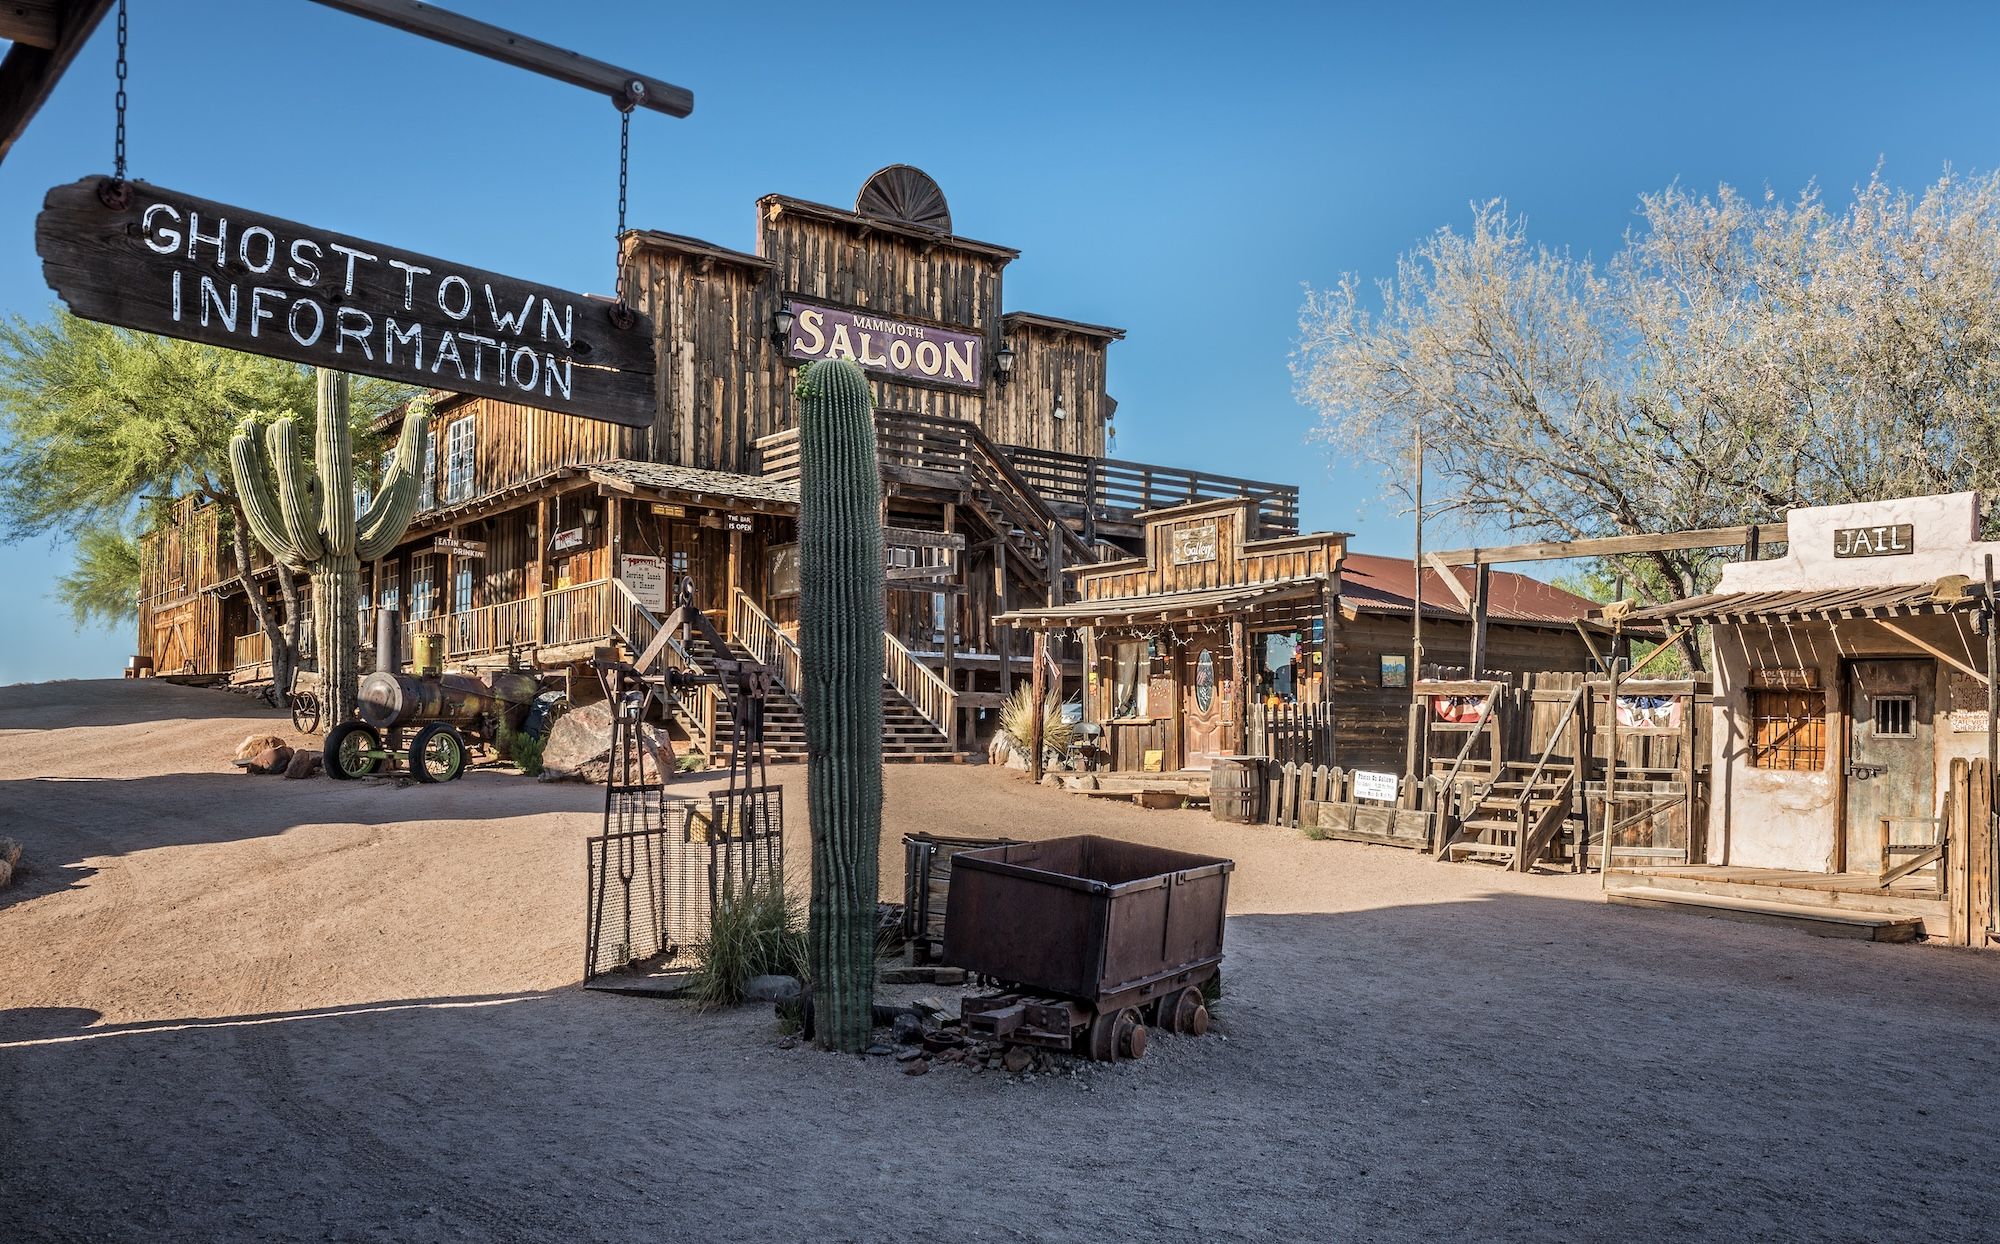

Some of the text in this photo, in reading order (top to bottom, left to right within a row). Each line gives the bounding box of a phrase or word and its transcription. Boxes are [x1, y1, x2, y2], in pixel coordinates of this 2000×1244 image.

[142, 203, 573, 349] GHOST TOWN
[172, 269, 573, 401] INFORMATION
[852, 314, 925, 340] MAMMOTH
[793, 308, 976, 384] SALOON
[727, 514, 752, 524] THE BAR
[728, 522, 752, 532] IS OPEN
[438, 537, 459, 547] EATIN
[1836, 526, 1906, 555] JAIL
[453, 547, 484, 558] DRINKIN
[1183, 541, 1213, 559] Gallery
[1767, 677, 1798, 685] JAIL
